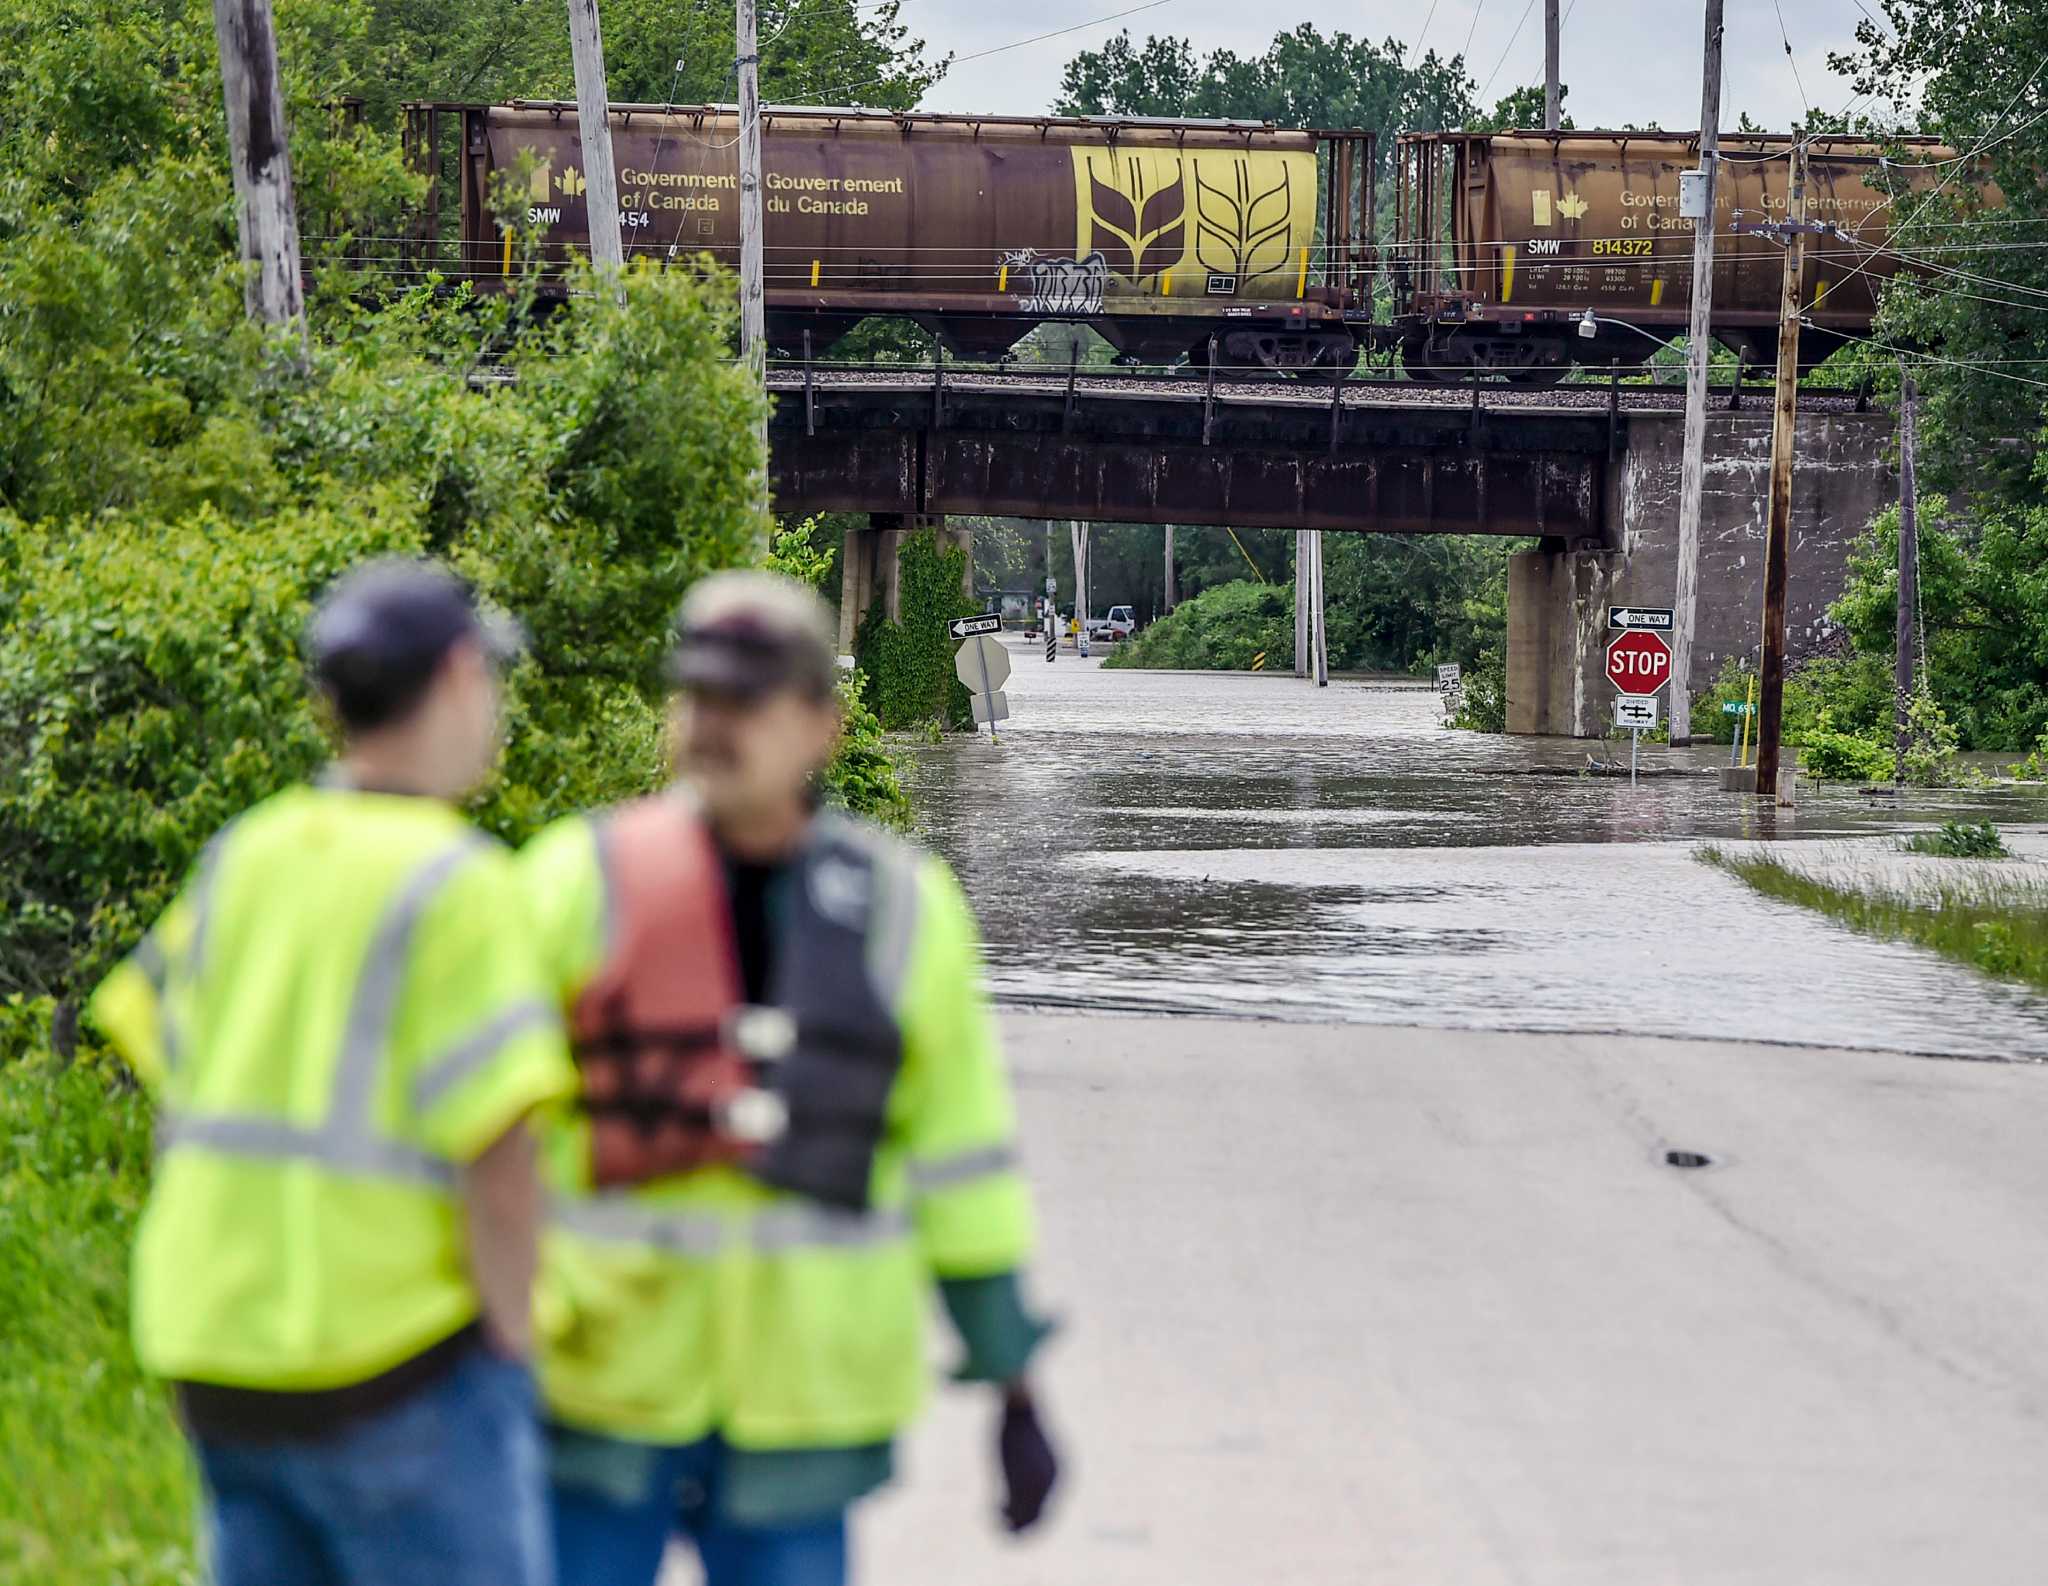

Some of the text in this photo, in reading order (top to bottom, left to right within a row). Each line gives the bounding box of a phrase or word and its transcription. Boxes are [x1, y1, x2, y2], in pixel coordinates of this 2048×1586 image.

[621, 168, 736, 189] Government
[621, 191, 719, 212] of Canada
[767, 195, 868, 215] du Canada
[528, 207, 560, 224] SMW
[1620, 212, 1697, 230] of Cana
[1528, 239, 1653, 255] SMW 814372
[964, 620, 995, 631] ONE WAY
[1628, 614, 1667, 624] ONE WAY
[1611, 650, 1667, 675] STOP
[1441, 679, 1460, 690] 25
